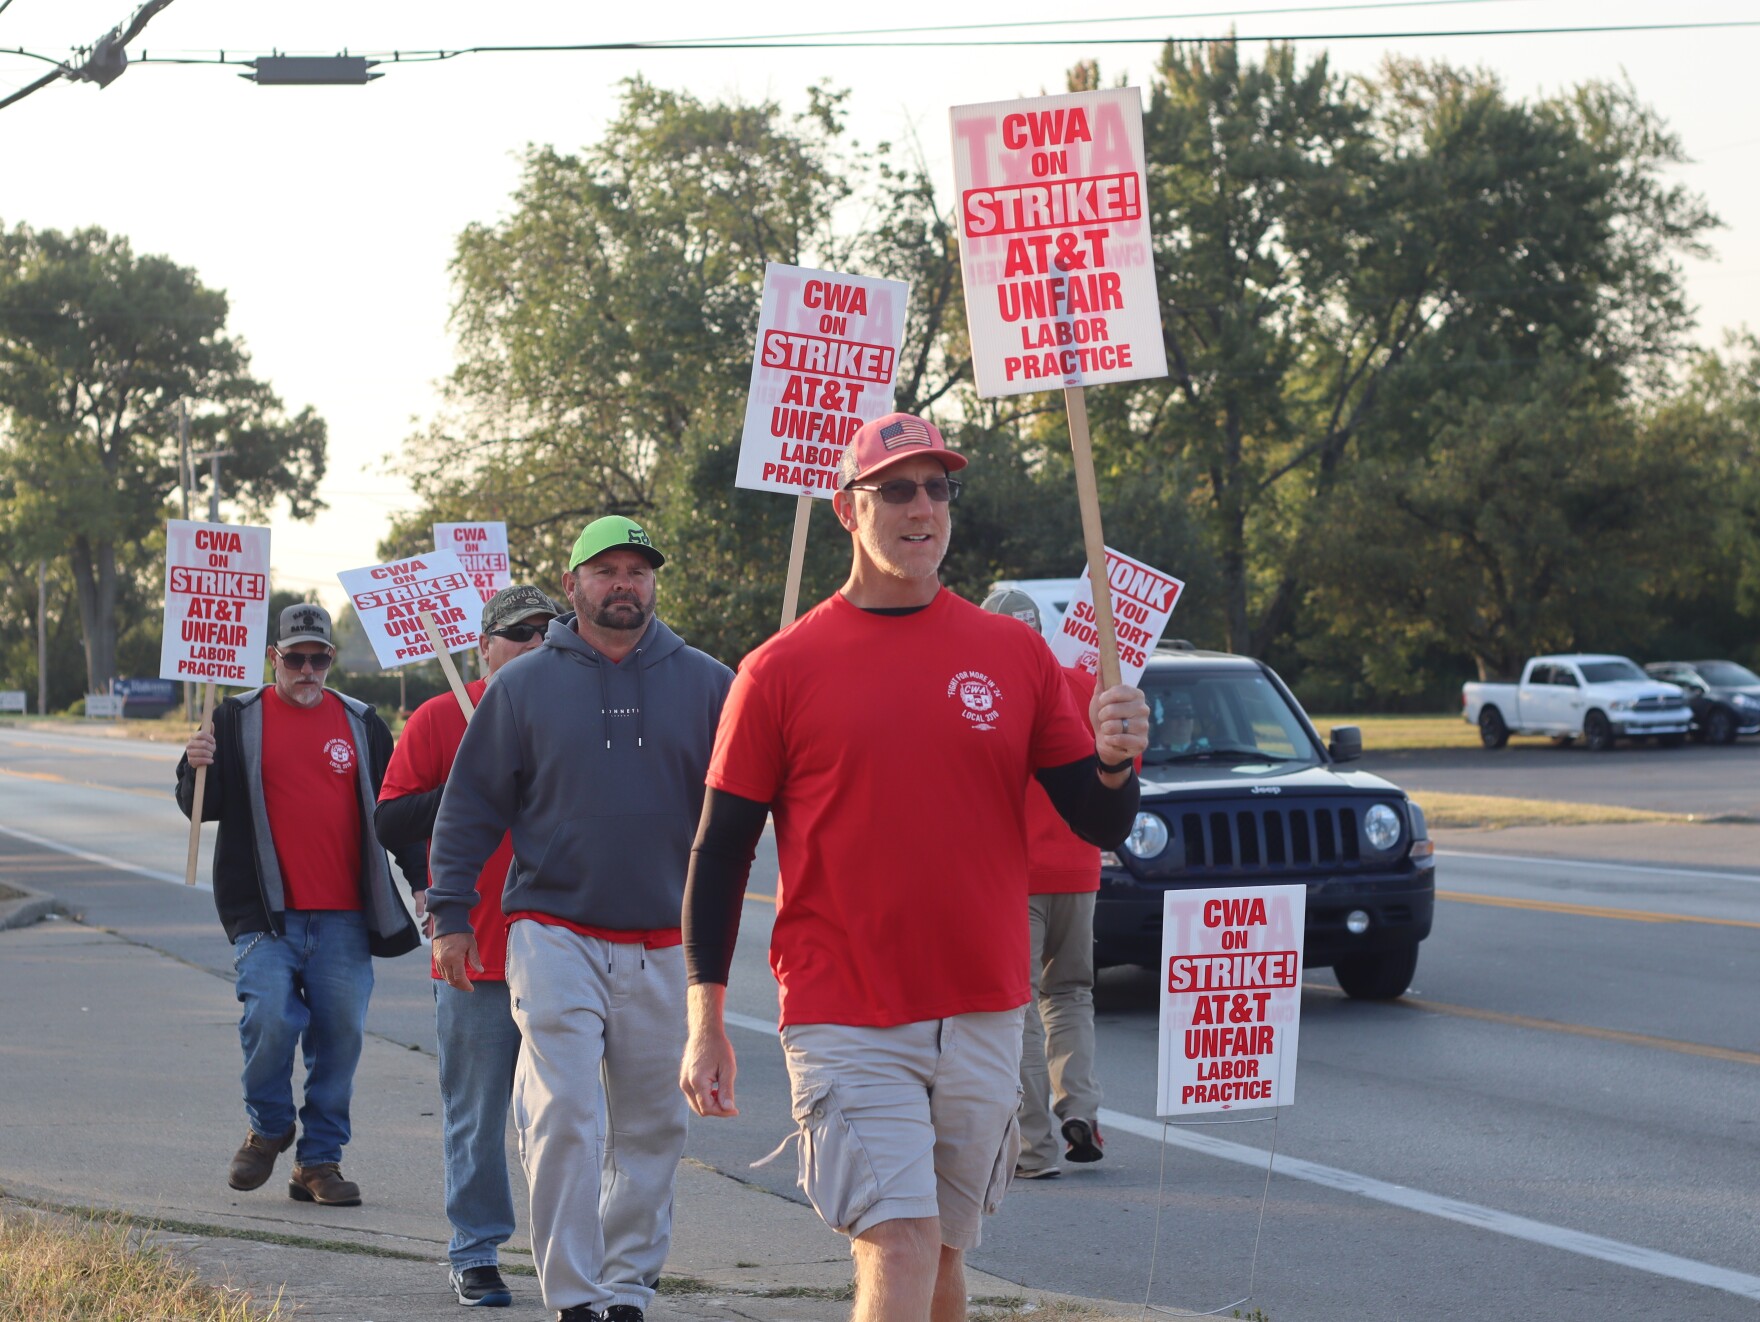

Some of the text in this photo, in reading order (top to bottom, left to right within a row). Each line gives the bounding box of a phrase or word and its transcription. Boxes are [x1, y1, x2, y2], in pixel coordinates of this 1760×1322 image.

[1002, 108, 1092, 150] CWA
[1032, 150, 1068, 177] ON
[967, 176, 1137, 232] STRIKE!
[1004, 229, 1109, 278] AT&T
[803, 280, 867, 316] CWA
[997, 272, 1124, 322] UNFAIR
[819, 314, 847, 335] ON
[1021, 318, 1108, 350] LABOR
[764, 333, 892, 380] STRIKE!
[1005, 344, 1133, 381] PRACTICE
[781, 375, 864, 414] AT&T
[762, 463, 839, 490] PRACTI
[195, 530, 242, 552] CWA
[454, 528, 487, 541] CWA
[465, 543, 478, 552] ON
[209, 554, 228, 568] ON
[371, 560, 428, 579] CWA
[459, 555, 505, 570] TRIKE!
[172, 568, 263, 598] STRIKE!
[357, 574, 466, 608] STRIKE!
[393, 574, 416, 584] ON
[187, 598, 245, 622] AT&T
[387, 594, 450, 620] AT&T
[1115, 597, 1149, 624] YOU
[182, 620, 247, 647] UNFAIR
[396, 632, 477, 659] PRATICE
[403, 625, 460, 645] LAOR
[1063, 617, 1147, 668] WORERS
[190, 646, 236, 662] LABOR
[178, 660, 245, 679] PRACTICE
[956, 671, 969, 681] FOR
[969, 671, 988, 682] MORE
[965, 685, 986, 695] CWA
[962, 709, 985, 722] LOCAL
[1251, 786, 1281, 794] Jeep
[1203, 898, 1267, 928] CWA
[1222, 930, 1248, 950] ON
[1172, 954, 1295, 990] STRIKE!
[1192, 992, 1271, 1026] AT&T
[1184, 1025, 1274, 1059] UNFAIR
[1197, 1060, 1258, 1081] LABOR
[1182, 1080, 1272, 1104] PRACTICE
